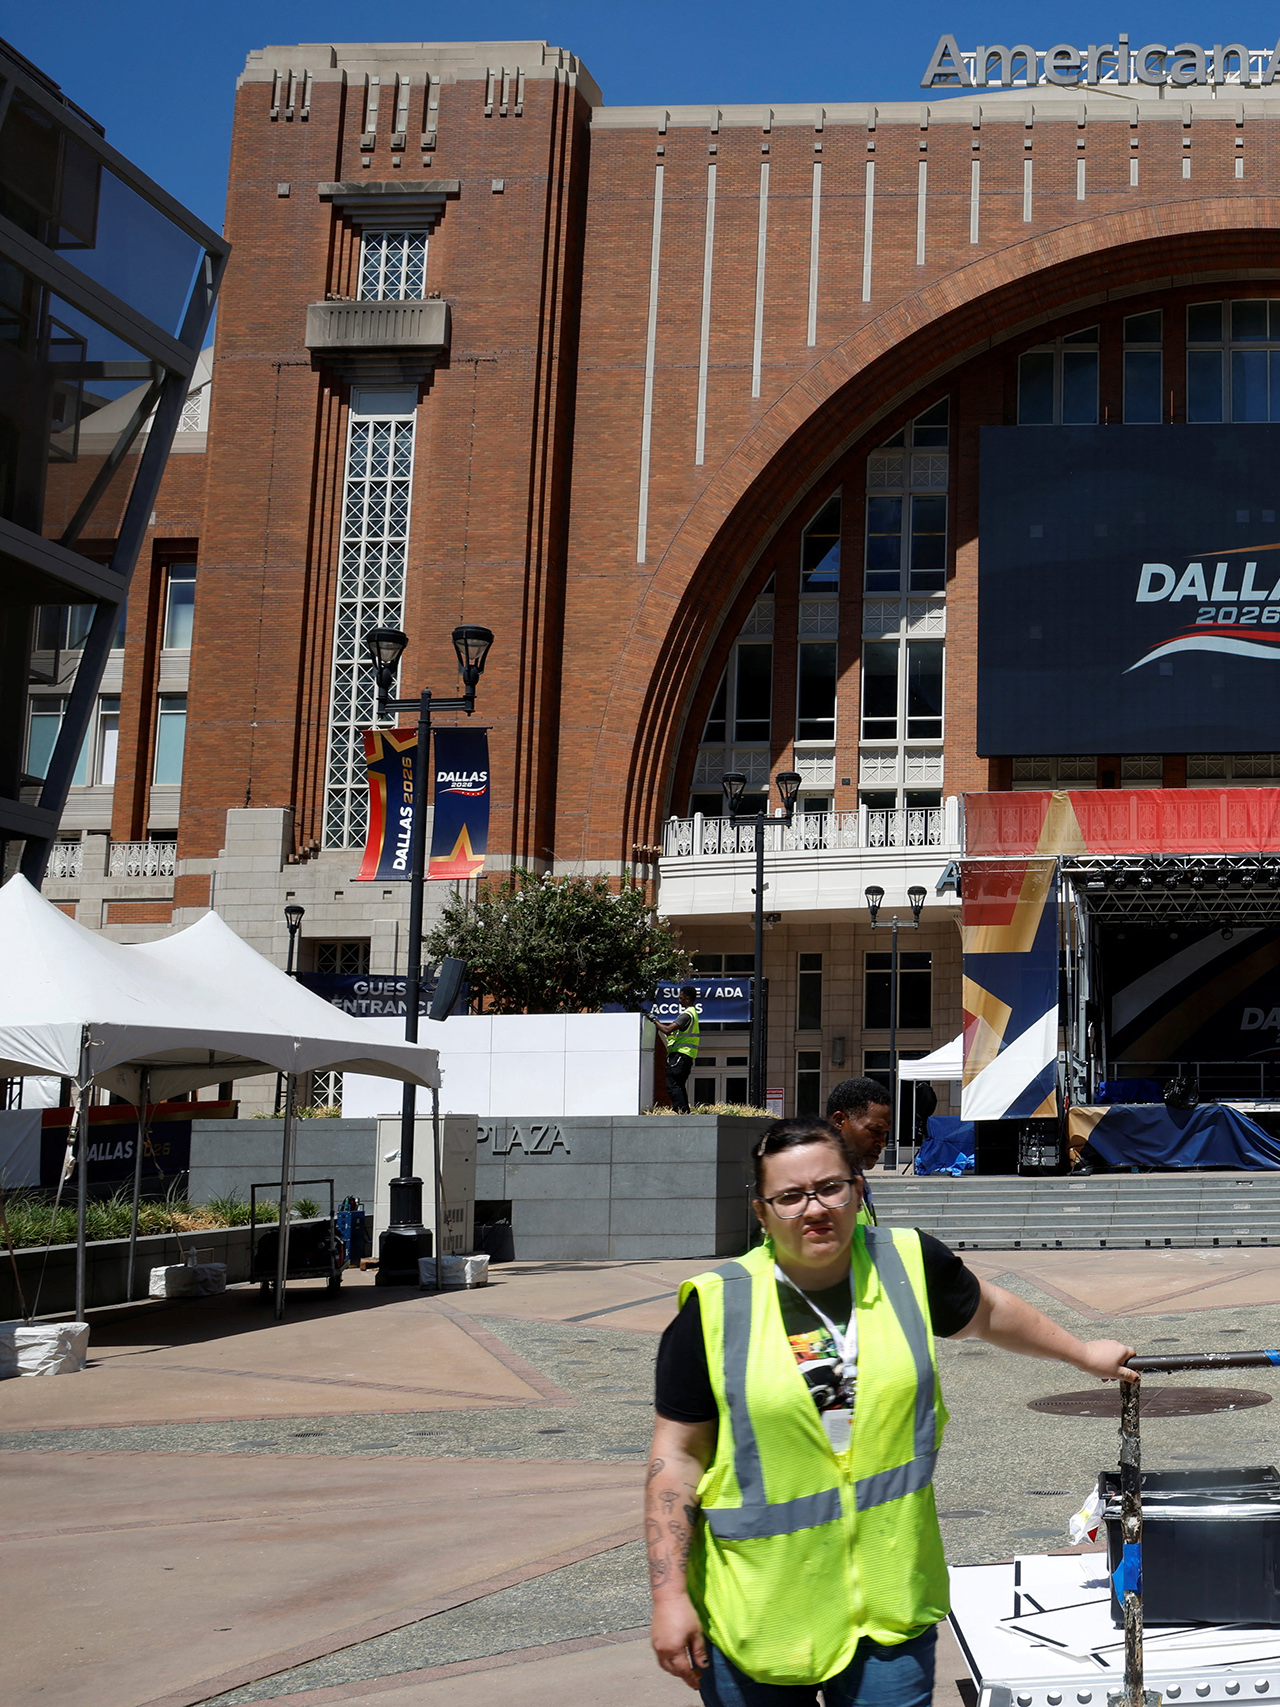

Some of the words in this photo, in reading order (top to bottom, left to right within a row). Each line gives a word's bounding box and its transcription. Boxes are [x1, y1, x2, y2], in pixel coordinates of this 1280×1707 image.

[1195, 606, 1280, 624] 2026
[402, 756, 413, 804] 2026
[437, 771, 488, 782] DALLAS
[392, 806, 413, 871] DALLAS
[354, 981, 407, 996] GUES
[663, 988, 701, 998] SUE
[705, 987, 712, 998] /
[715, 987, 743, 998] ADA
[650, 1003, 703, 1014] ACCES
[477, 1123, 571, 1155] PLAZA
[78, 1140, 134, 1162] ALLAS
